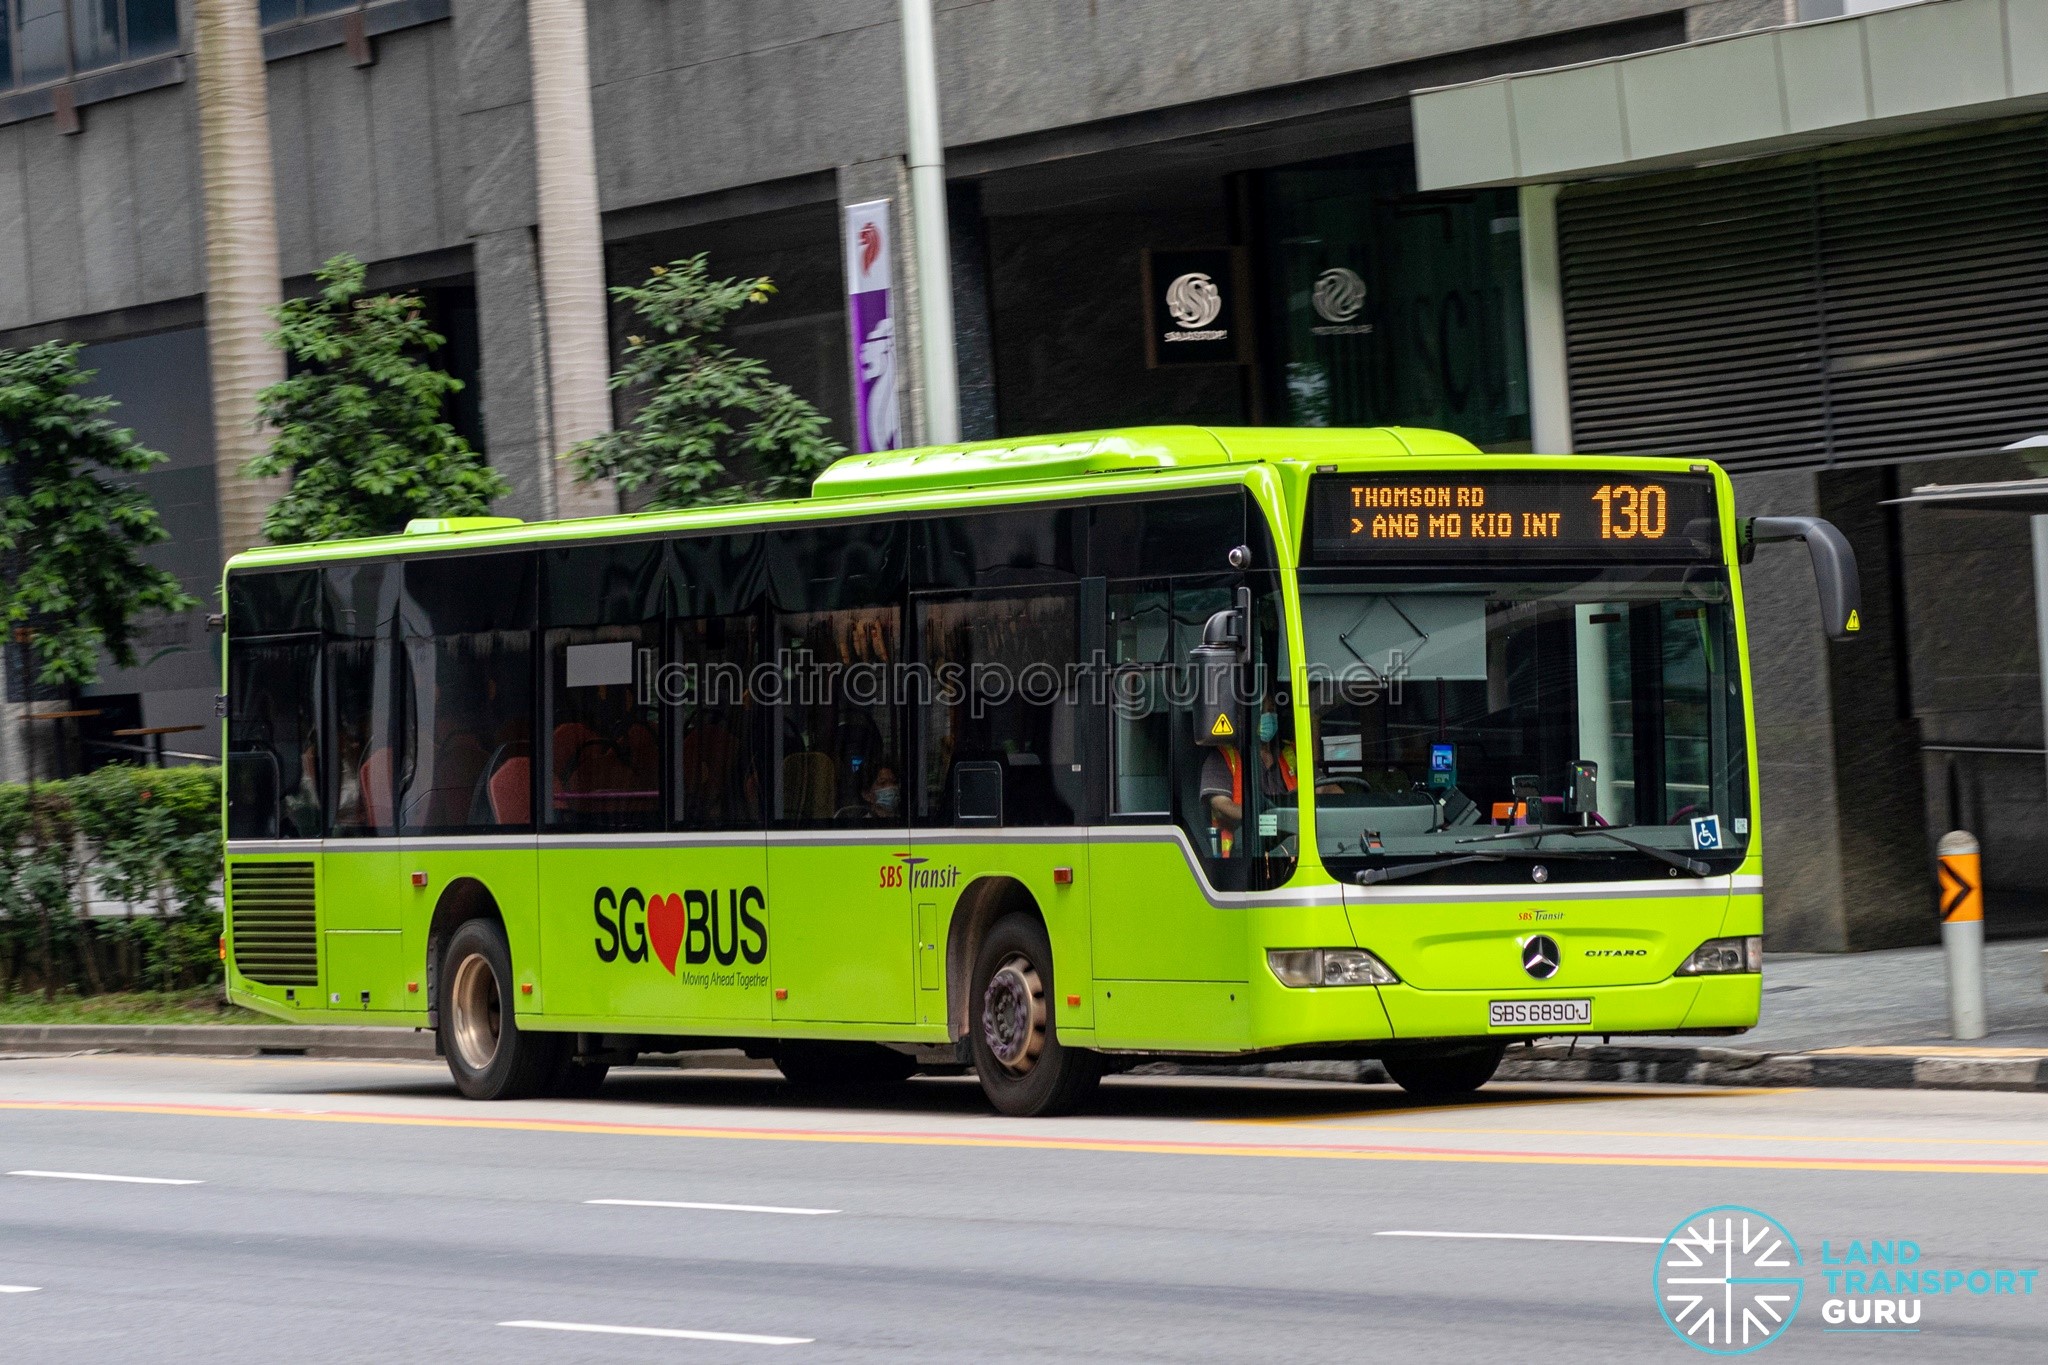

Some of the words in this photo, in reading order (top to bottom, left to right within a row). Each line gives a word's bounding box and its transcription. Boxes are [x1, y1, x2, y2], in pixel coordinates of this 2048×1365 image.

[1351, 487, 1451, 507] THOMSON
[1457, 487, 1485, 507] RD
[1592, 485, 1667, 538] 130
[1372, 513, 1419, 538] ANG
[1429, 513, 1461, 538] MO
[1471, 513, 1512, 538] KIO
[1522, 513, 1561, 538] INT
[879, 864, 903, 888] SBS
[901, 857, 961, 894] Transit
[1518, 912, 1532, 921] SBS
[1533, 909, 1564, 921] Transit
[1584, 949, 1648, 957] CITARO
[682, 971, 709, 989] Moving
[710, 971, 735, 986] Ahead
[736, 972, 769, 990] Together
